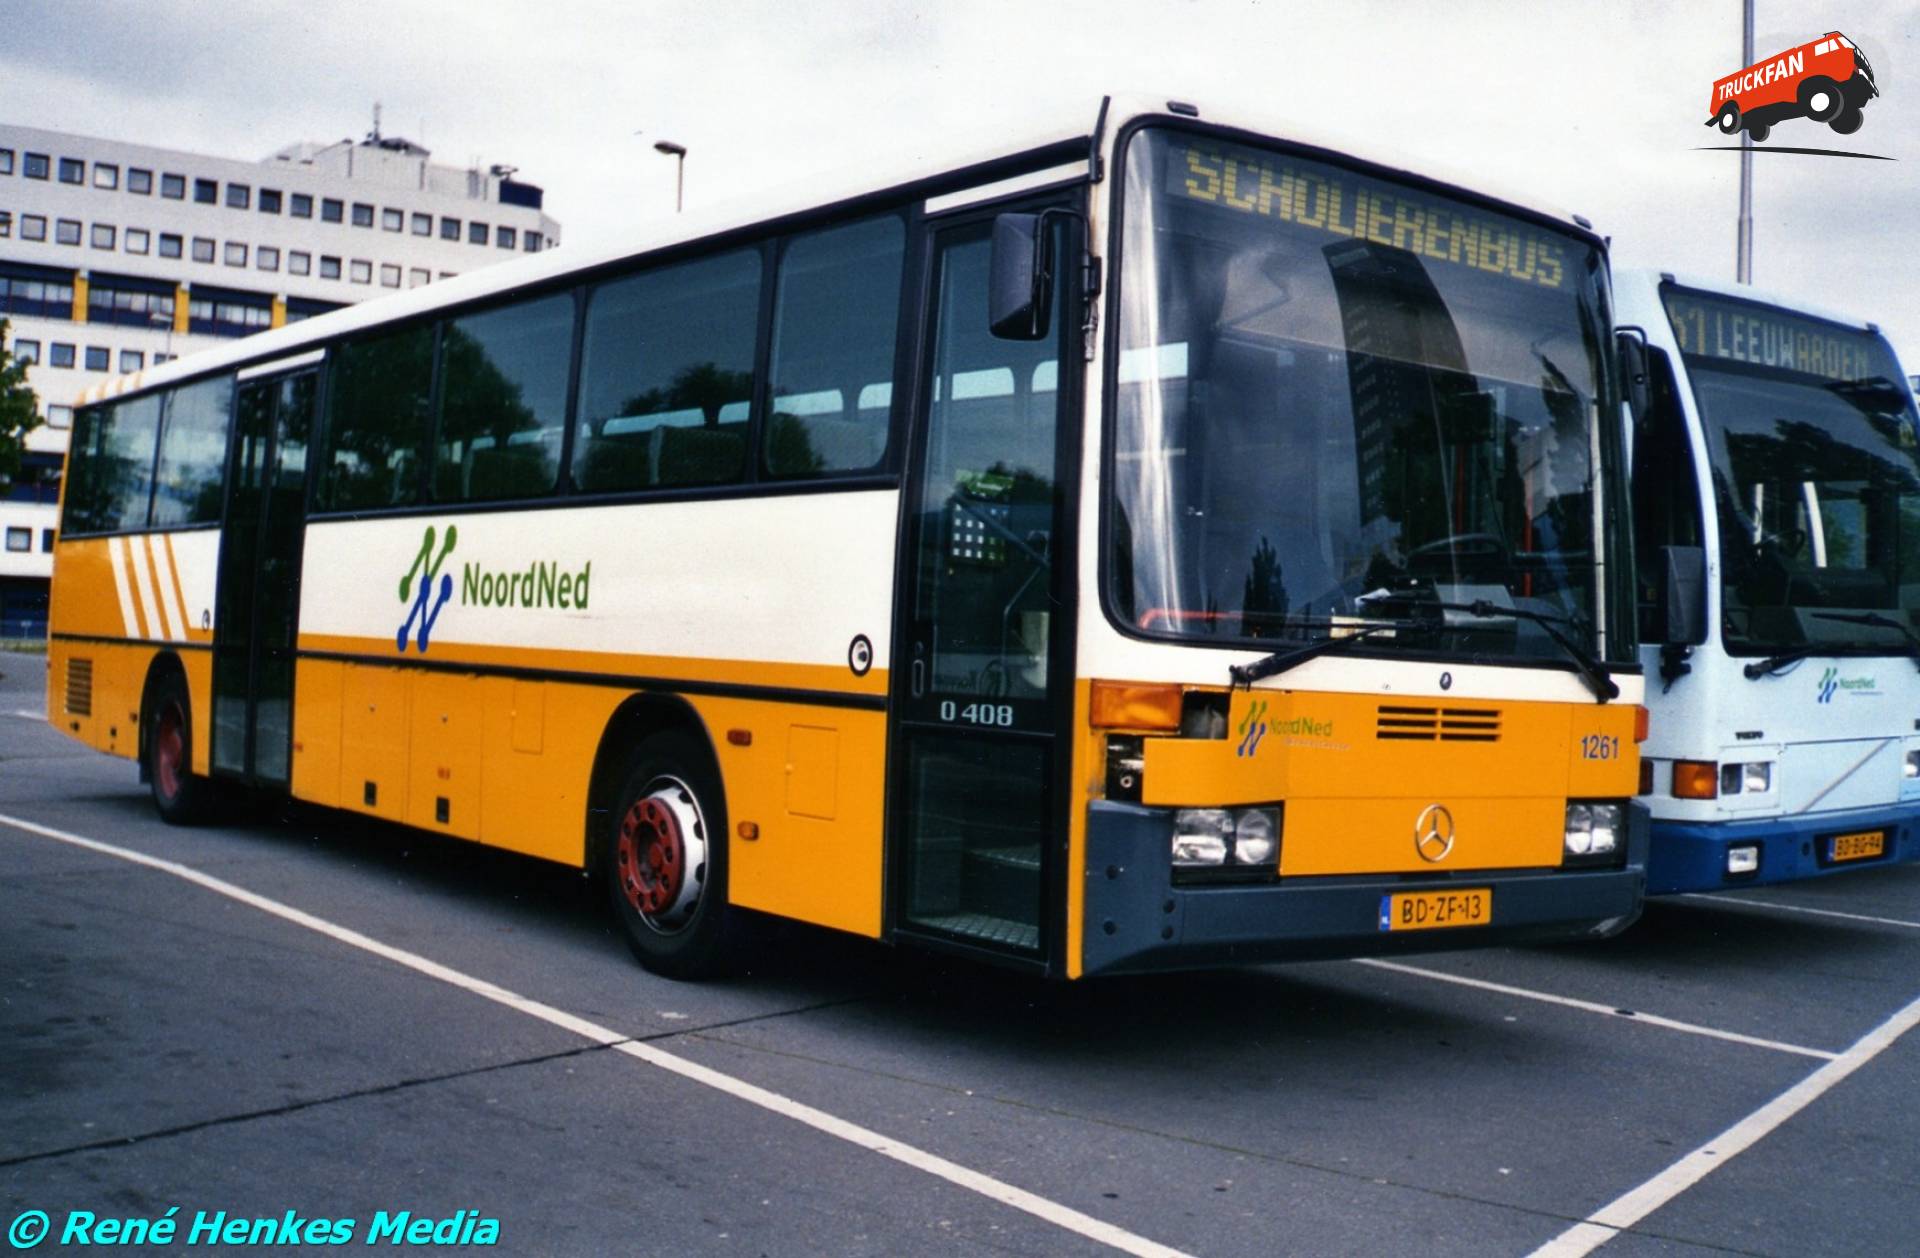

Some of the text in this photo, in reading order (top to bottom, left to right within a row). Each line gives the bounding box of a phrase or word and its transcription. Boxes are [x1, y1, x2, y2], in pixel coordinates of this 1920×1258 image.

[1185, 149, 1563, 288] SCHOLIERENBUS
[1717, 311, 1869, 382] LEEUWARDEN
[462, 560, 591, 609] NoordNed
[961, 703, 1013, 726] 408
[1270, 717, 1333, 737] NoordNed
[1581, 735, 1619, 759] 1261
[1402, 895, 1482, 924] BD-ZF-13
